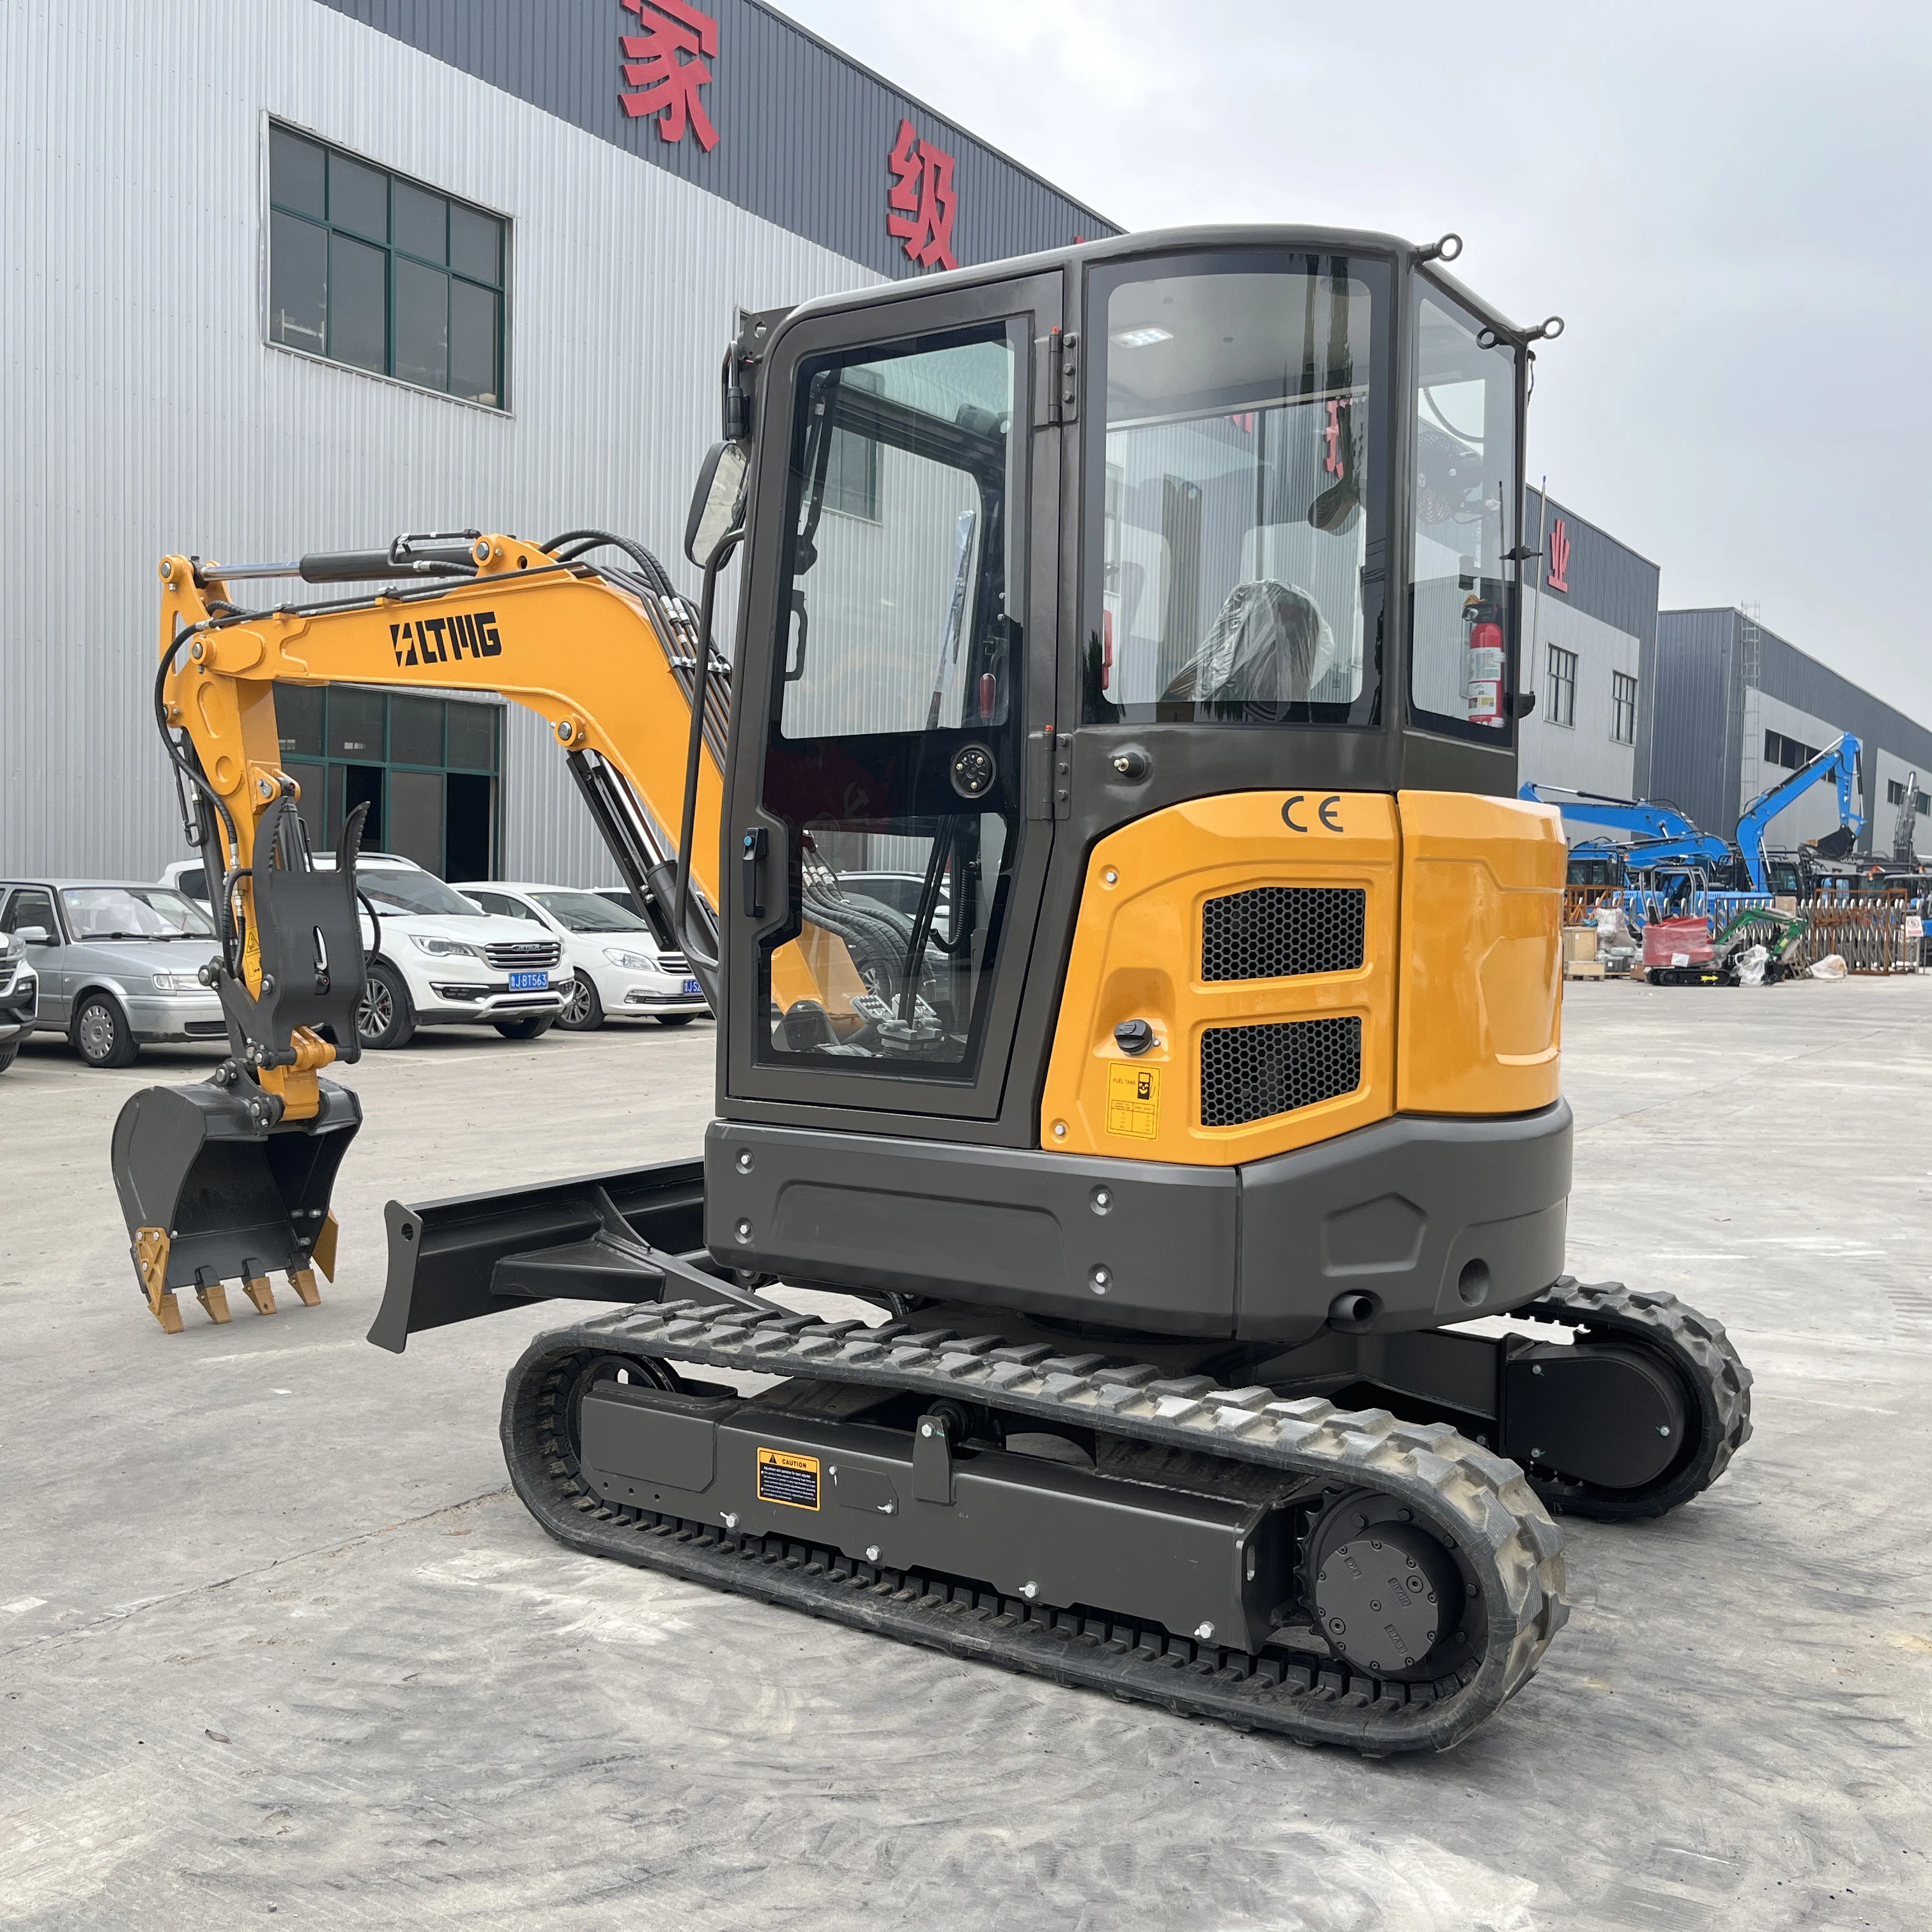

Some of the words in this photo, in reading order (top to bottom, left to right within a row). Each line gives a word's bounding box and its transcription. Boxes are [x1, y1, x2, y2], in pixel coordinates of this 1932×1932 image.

[618, 0, 719, 153] 家
[887, 118, 957, 270] 级
[1547, 518, 1570, 593] 业
[1282, 795, 1344, 832] CE
[782, 1458, 807, 1469] CAUTION
